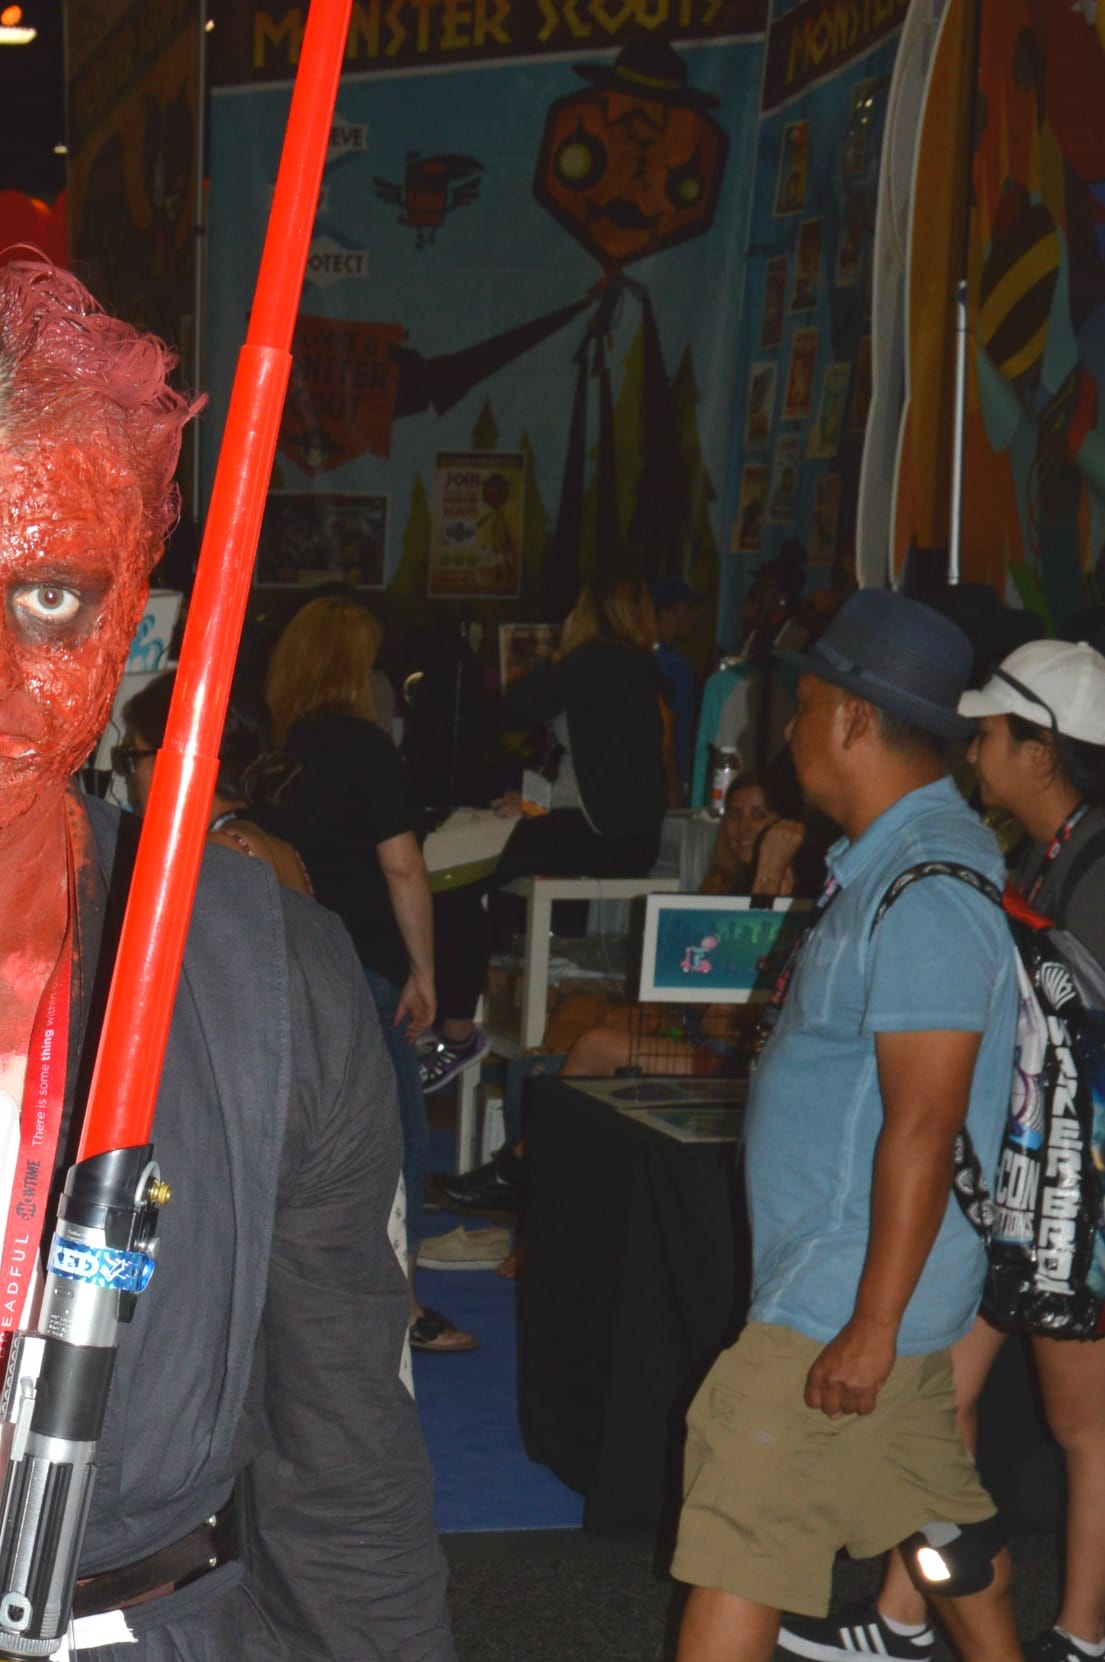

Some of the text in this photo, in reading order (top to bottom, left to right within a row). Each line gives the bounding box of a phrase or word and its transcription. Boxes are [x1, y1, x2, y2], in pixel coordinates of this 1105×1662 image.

[251, 0, 512, 71] MNSTER
[784, 0, 906, 87] MONSTE
[331, 127, 364, 147] EVE
[309, 255, 365, 274] OTECT
[41, 1028, 56, 1062] thing
[38, 1063, 51, 1097] some
[37, 1098, 47, 1110] is
[30, 1111, 47, 1147] There
[15, 1158, 42, 1222] SHOWTIME
